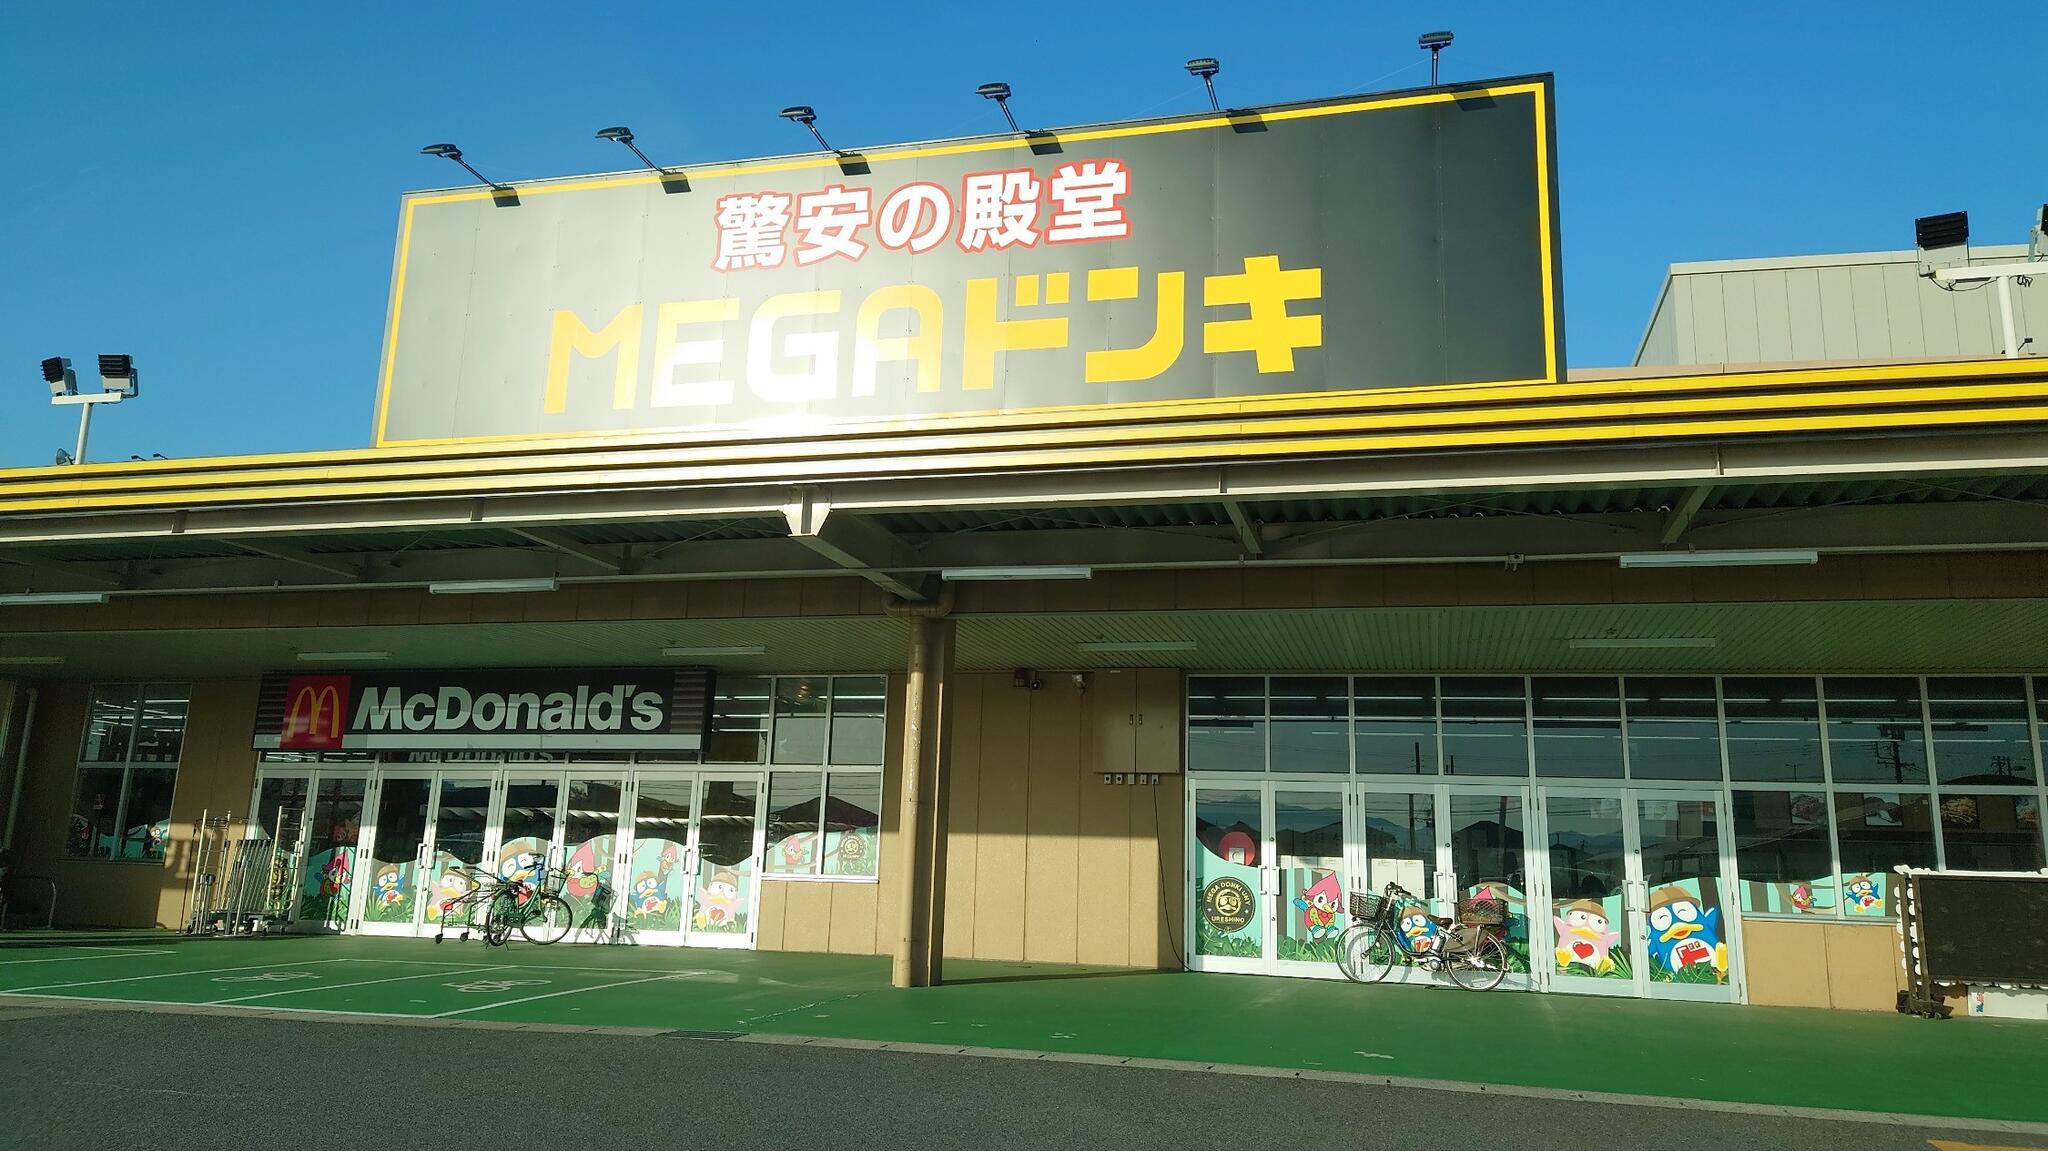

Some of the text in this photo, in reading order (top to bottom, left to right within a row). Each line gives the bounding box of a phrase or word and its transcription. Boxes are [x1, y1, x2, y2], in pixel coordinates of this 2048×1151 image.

[711, 158, 1132, 272] 驚安の殿堂
[543, 255, 1323, 415] MEGAドンキ
[351, 684, 664, 731] McDonald's
